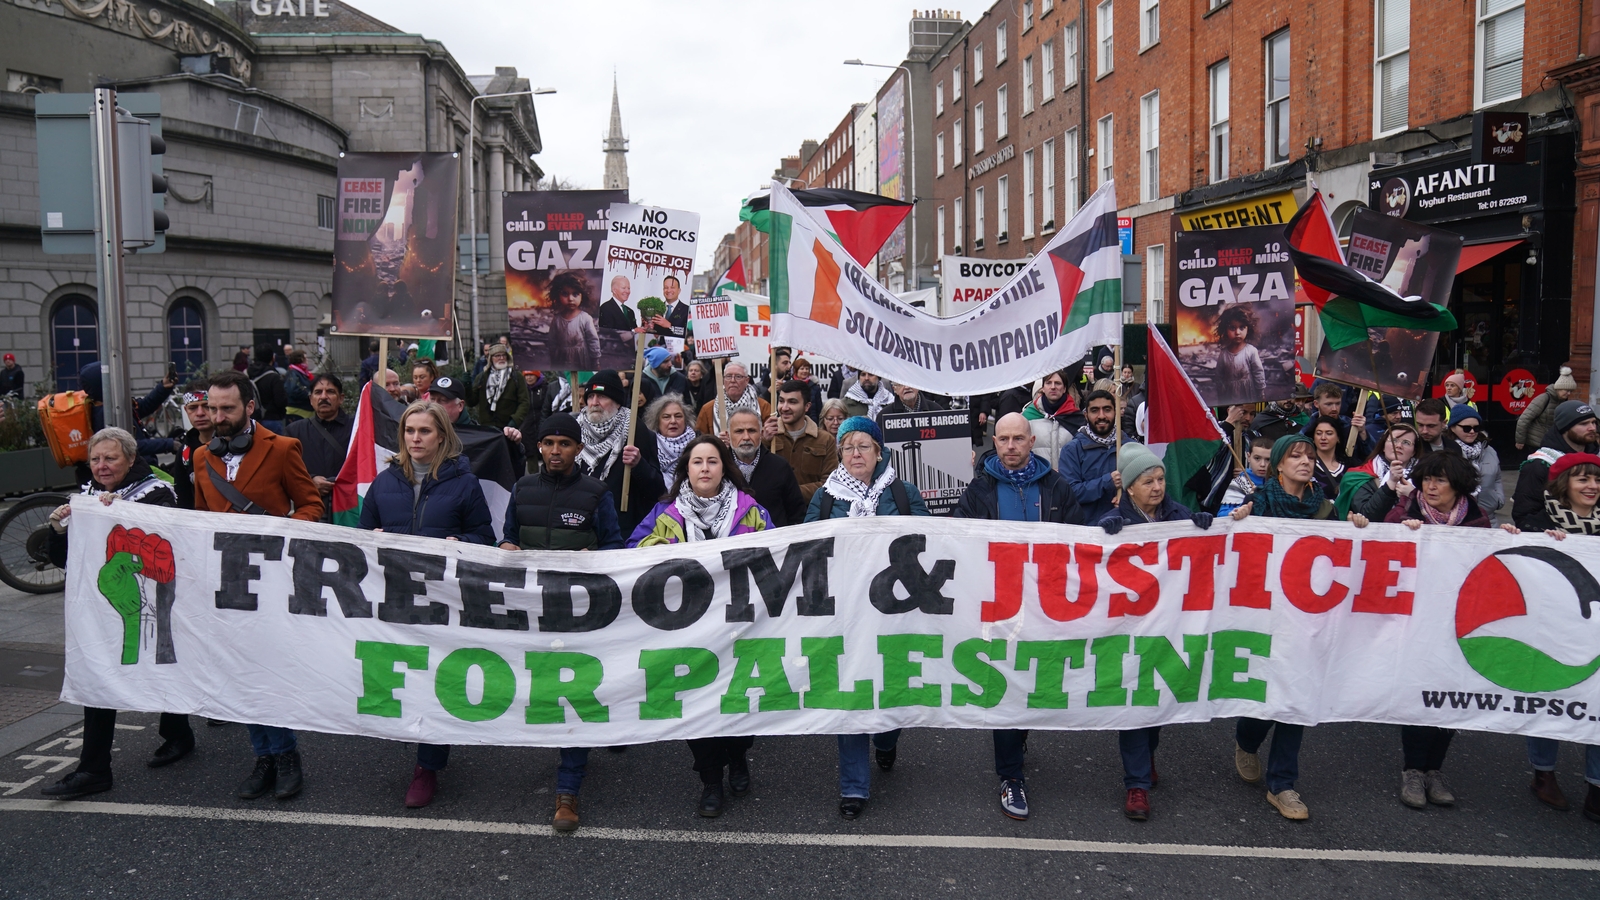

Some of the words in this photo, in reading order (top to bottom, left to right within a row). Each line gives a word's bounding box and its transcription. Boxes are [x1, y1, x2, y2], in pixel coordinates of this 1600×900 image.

[250, 0, 330, 17] GATE
[344, 181, 382, 193] CEASE
[1371, 180, 1381, 190] 3A
[1413, 164, 1496, 197] AFANTI
[343, 198, 381, 213] FIRE
[1419, 197, 1446, 209] Uyghur
[1447, 188, 1491, 203] Restaurant
[1477, 202, 1489, 210] Tel:
[1489, 200, 1498, 208] 01
[1499, 195, 1528, 207] 8729379
[521, 210, 528, 220] 1
[547, 213, 585, 222] KILLED
[642, 209, 668, 224] NO
[506, 221, 546, 231] CHILD
[547, 221, 585, 231] EVERY
[587, 220, 609, 230] MI
[611, 221, 696, 243] SHAMROCKS
[559, 232, 572, 241] IN
[640, 238, 664, 251] FOR
[1265, 243, 1280, 253] 10
[1352, 236, 1388, 255] CEASE
[610, 247, 667, 265] GENOCIDE
[668, 257, 690, 269] JOE
[1194, 249, 1200, 258] 1
[1218, 248, 1253, 257] KILLED
[1255, 252, 1289, 264] MINS
[1179, 258, 1217, 270] CHILD
[1218, 256, 1252, 267] EVERY
[1350, 252, 1384, 274] FIRE
[960, 263, 1026, 277] BOYCOT
[1229, 267, 1241, 276] IN
[953, 288, 1000, 302] APAR
[1179, 272, 1289, 308] GAZA
[696, 302, 730, 320] FREEDOM
[709, 322, 720, 334] FOR
[740, 323, 771, 337] ETH
[696, 336, 737, 354] PALESTINE!
[950, 311, 1058, 372] CAMPAIGN
[885, 418, 912, 429] CHECK
[914, 416, 930, 427] THE
[931, 414, 969, 426] BARCODE
[920, 428, 936, 438] 729
[214, 532, 835, 632] FREEDOM
[869, 533, 957, 615] &
[981, 532, 1417, 622] JUSTICE
[355, 640, 609, 724] FOR
[638, 629, 1272, 720] PALESTINE
[1422, 691, 1600, 722] WWW.IPSC.
